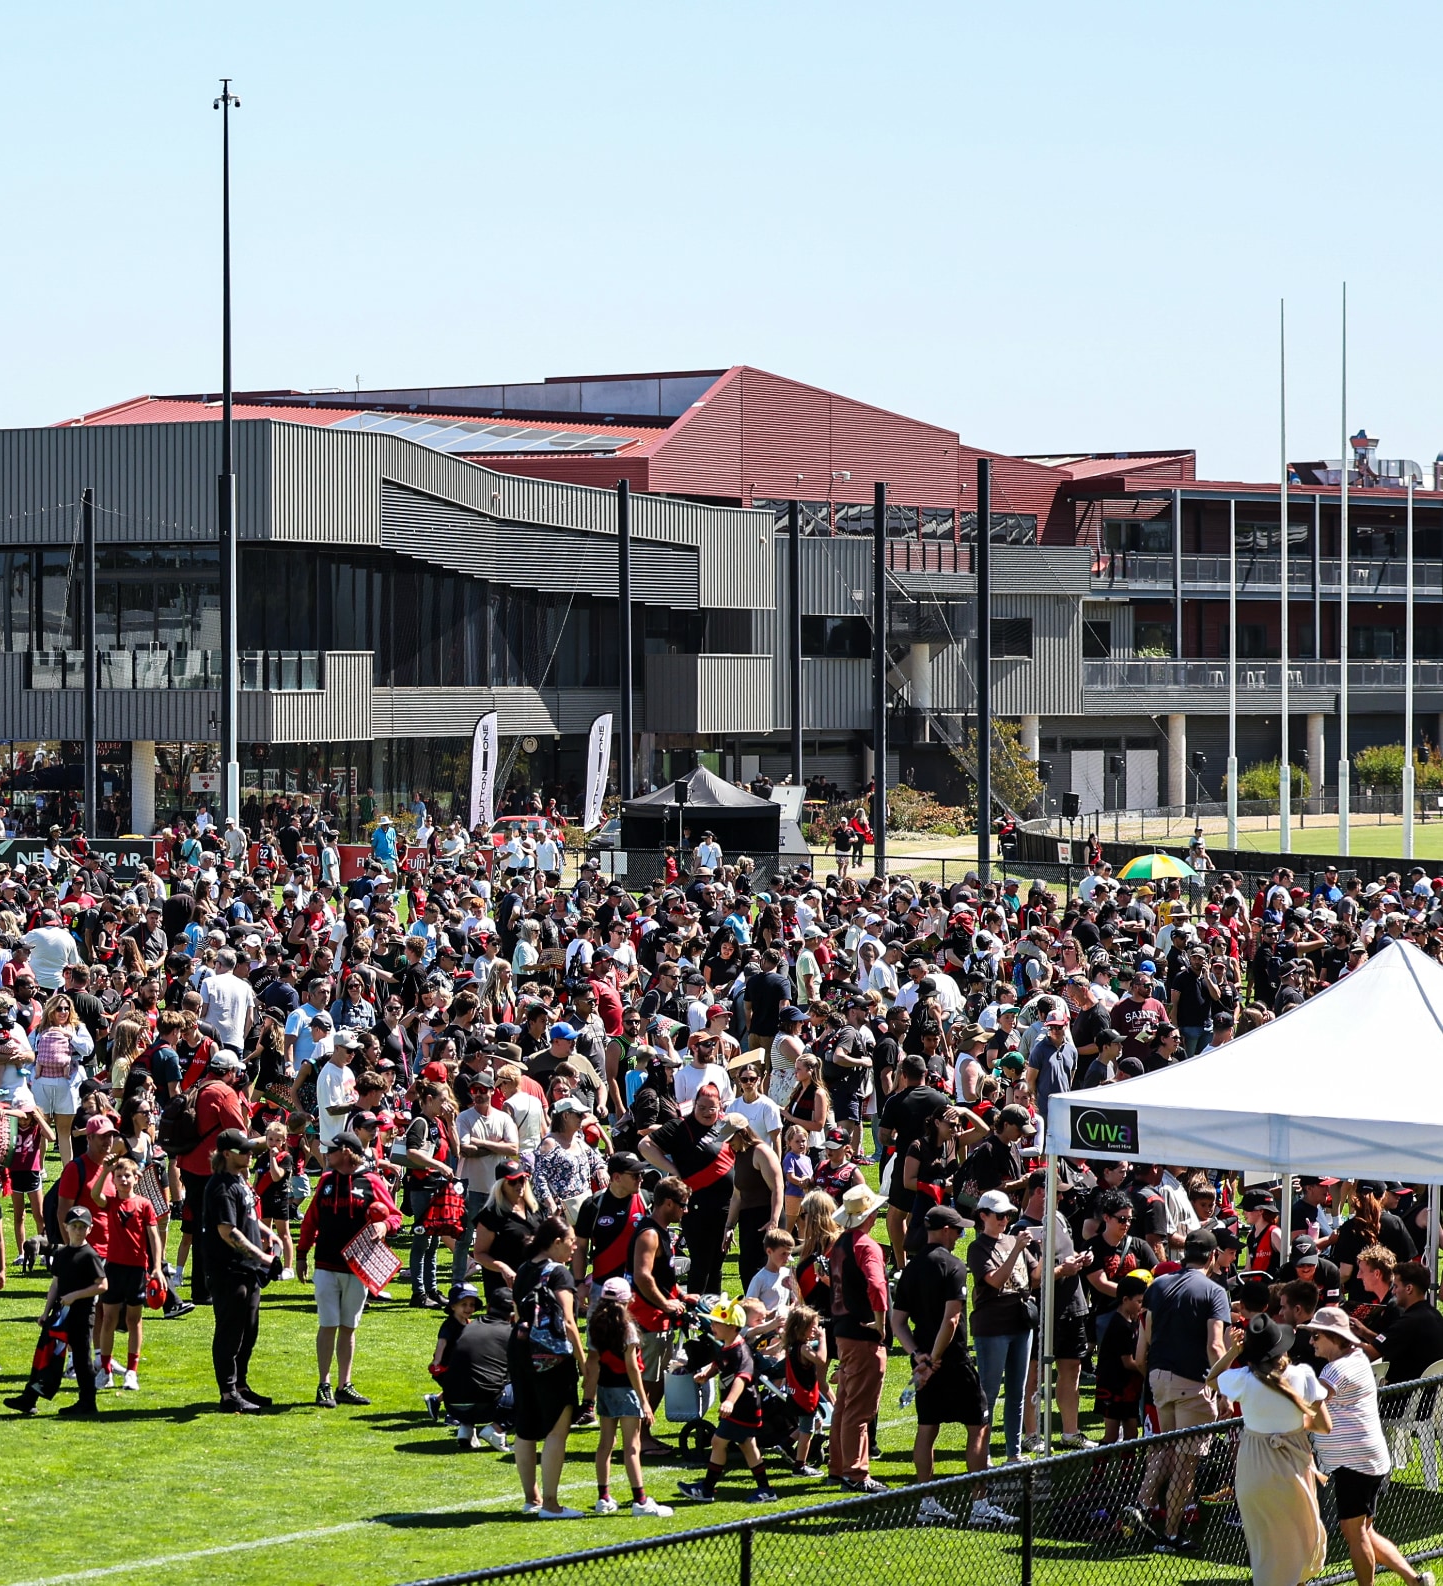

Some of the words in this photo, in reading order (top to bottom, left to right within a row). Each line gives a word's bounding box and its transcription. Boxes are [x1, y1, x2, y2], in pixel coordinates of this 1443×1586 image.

[260, 848, 269, 859] 22
[254, 975, 272, 989] TOMMY
[1125, 1009, 1159, 1023] SAINT
[1085, 1122, 1132, 1143] VIVa
